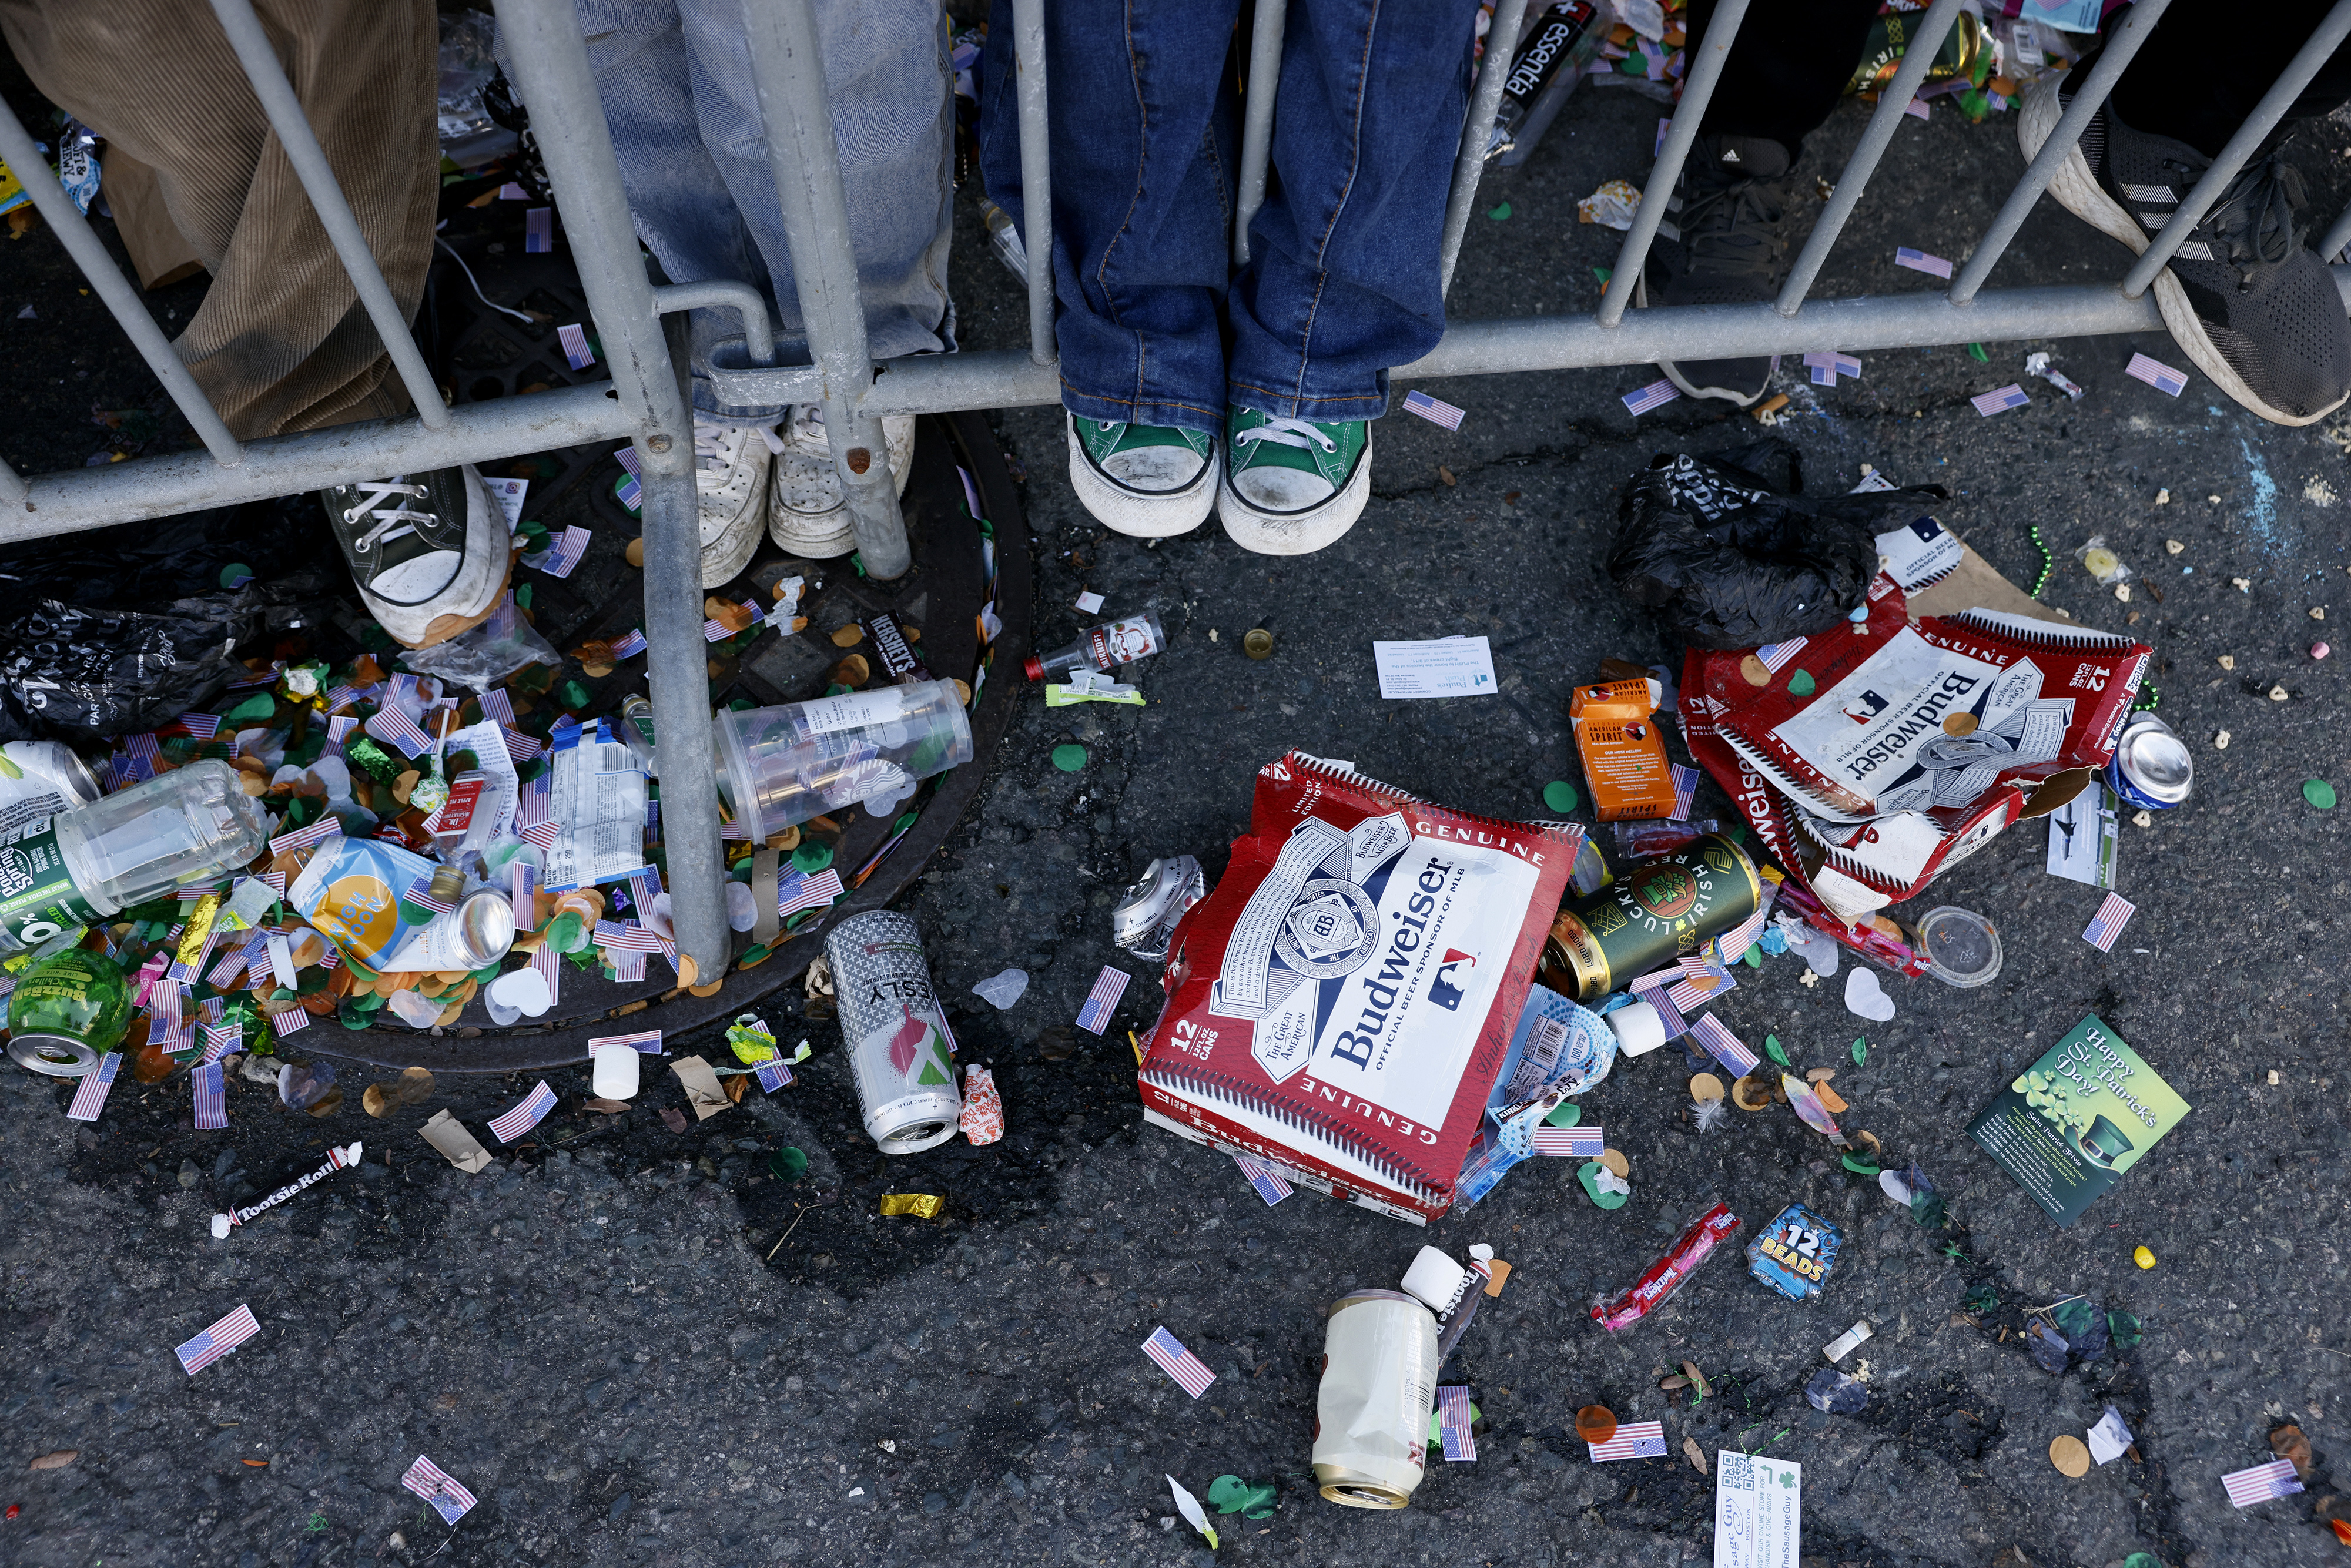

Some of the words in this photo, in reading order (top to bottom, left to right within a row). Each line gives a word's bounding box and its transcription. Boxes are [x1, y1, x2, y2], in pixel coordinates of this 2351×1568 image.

[1504, 21, 1570, 95] essentia
[1906, 549, 1935, 571] OFFICIAL
[1935, 536, 1953, 551] BEER
[1906, 554, 1937, 577] SPONSOR
[1937, 547, 1946, 555] OF
[1947, 540, 1957, 550] ML
[870, 613, 916, 673] HERSHEY'S
[1093, 632, 1111, 669] SMIRNOFF
[875, 641, 884, 652] milk
[880, 651, 897, 678] chocolate
[1613, 680, 1646, 691] SPIRIT
[1911, 670, 1944, 702] OFFICIAL
[2017, 671, 2032, 688] THE
[2068, 662, 2087, 687] CANS
[2085, 665, 2111, 692] 12
[1992, 673, 2021, 708] AMERICAN
[2003, 684, 2024, 710] GREAT
[1689, 695, 1708, 716] 12
[1891, 701, 1913, 719] BEER
[2105, 703, 2121, 723] Fanatics
[1589, 724, 1621, 733] AMERICAN
[1590, 731, 1622, 742] SPIRIT
[1844, 670, 1980, 782] Budweiser
[1858, 717, 1894, 745] SPONSOR
[2092, 722, 2110, 749] Experience
[2111, 717, 2126, 736] shop
[1835, 750, 1852, 763] MLB
[1850, 742, 1861, 751] OF
[1763, 729, 1866, 809] GENUINE
[1291, 779, 1312, 812] LIMITED
[1301, 781, 1321, 815] EDITION
[29, 847, 40, 864] NATURAL
[35, 846, 45, 858] WATER
[1292, 830, 1315, 852] produced
[1355, 825, 1385, 858] BUDWEISER
[1415, 821, 1545, 867] GENUINE
[0, 846, 34, 890] Spring
[15, 855, 24, 866] 1845
[34, 862, 43, 873] 100%
[39, 857, 49, 870] SPRING
[1279, 867, 1286, 876] no
[1281, 849, 1295, 867] brand
[1644, 853, 1687, 866] RED
[52, 881, 68, 891] REPEAT
[1258, 892, 1267, 902] We
[1263, 879, 1277, 894] know
[1687, 865, 1714, 926] IRISH
[9, 897, 26, 907] PLEASE
[327, 890, 367, 938] HIGH
[1251, 900, 1262, 914] beer.
[1615, 872, 1673, 938] LUCKY'S
[341, 896, 386, 950] NOON
[1143, 912, 1157, 923] CALORIES
[1238, 913, 1255, 942] Budweiser
[1287, 932, 1300, 950] UNITED
[1306, 890, 1325, 903] STATES
[1358, 929, 1377, 956] AMERICA
[1567, 929, 1585, 946] HOBO
[1233, 943, 1244, 964] famous
[1328, 951, 1340, 963] THE
[1329, 855, 1454, 1071] Budweiser
[1375, 1012, 1404, 1070] OFFICIAL
[1400, 976, 1419, 1010] BEER
[1415, 913, 1445, 975] SPONSOR
[1441, 894, 1453, 912] OF
[1449, 866, 1465, 893] MLB
[1579, 947, 1593, 967] LORD
[862, 973, 889, 986] BEVERAGE
[868, 981, 932, 1004] ESLY
[1168, 1017, 1198, 1052] 12
[1273, 1009, 1296, 1041] GREAT
[1279, 1011, 1307, 1060] AMERICAN
[1191, 1026, 1210, 1057] 12FL.OZ.
[1198, 1029, 1220, 1061] CANS
[1264, 1040, 1283, 1060] THE
[1569, 1047, 1583, 1061] 100
[1575, 1033, 1583, 1047] CALORIES
[2084, 1026, 2135, 1080] Happy
[2053, 1053, 2099, 1098] Day!
[2067, 1040, 2090, 1066] St.
[2092, 1064, 2158, 1128] Patrick's
[1300, 1076, 1439, 1145] GENUINE
[1994, 1113, 2003, 1123] True
[2007, 1125, 2018, 1137] False:
[2021, 1140, 2034, 1154] Patrick
[2039, 1158, 2049, 1169] Irish.
[2012, 1105, 2021, 1115] How
[2020, 1114, 2031, 1125] much
[2034, 1128, 2042, 1138] you
[2041, 1135, 2052, 1147] know
[2051, 1145, 2063, 1158] about
[2062, 1155, 2073, 1167] Saint
[2071, 1165, 2087, 1182] Patrick?
[2024, 1110, 2043, 1128] Saint
[2041, 1126, 2064, 1149] Patrick
[2061, 1146, 2082, 1167] Trivia
[1191, 1115, 1391, 1201] Budweiser
[236, 1183, 300, 1222] Tootsie
[297, 1161, 335, 1189] Roll
[1785, 1223, 1821, 1258] 12
[1760, 1236, 1824, 1281] BEADS
[1643, 1266, 1678, 1299] Twizzlers
[1727, 1533, 1739, 1566] sage
